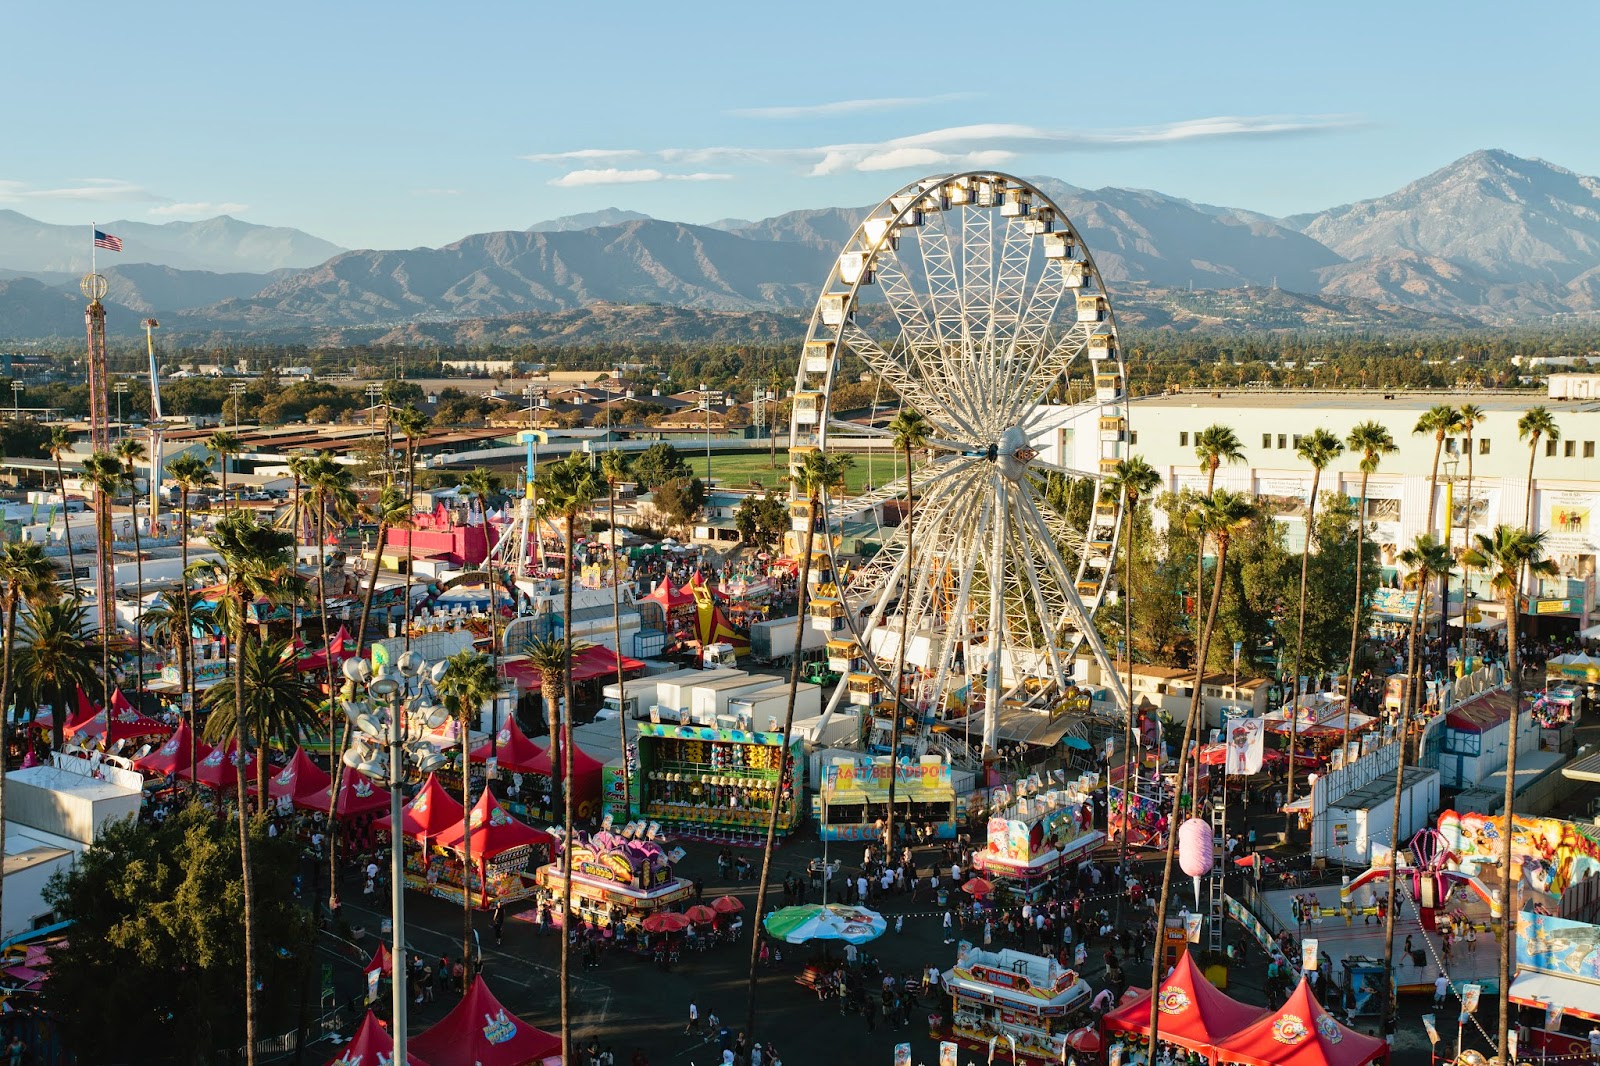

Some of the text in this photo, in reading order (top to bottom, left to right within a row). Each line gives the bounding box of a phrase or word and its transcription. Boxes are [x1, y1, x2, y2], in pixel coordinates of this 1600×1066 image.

[836, 766, 868, 778] RAFT
[906, 766, 948, 778] DEPOT
[837, 825, 858, 840] ICE
[1168, 996, 1177, 1005] A
[1282, 1014, 1303, 1023] BANK
[1283, 1025, 1294, 1034] A
